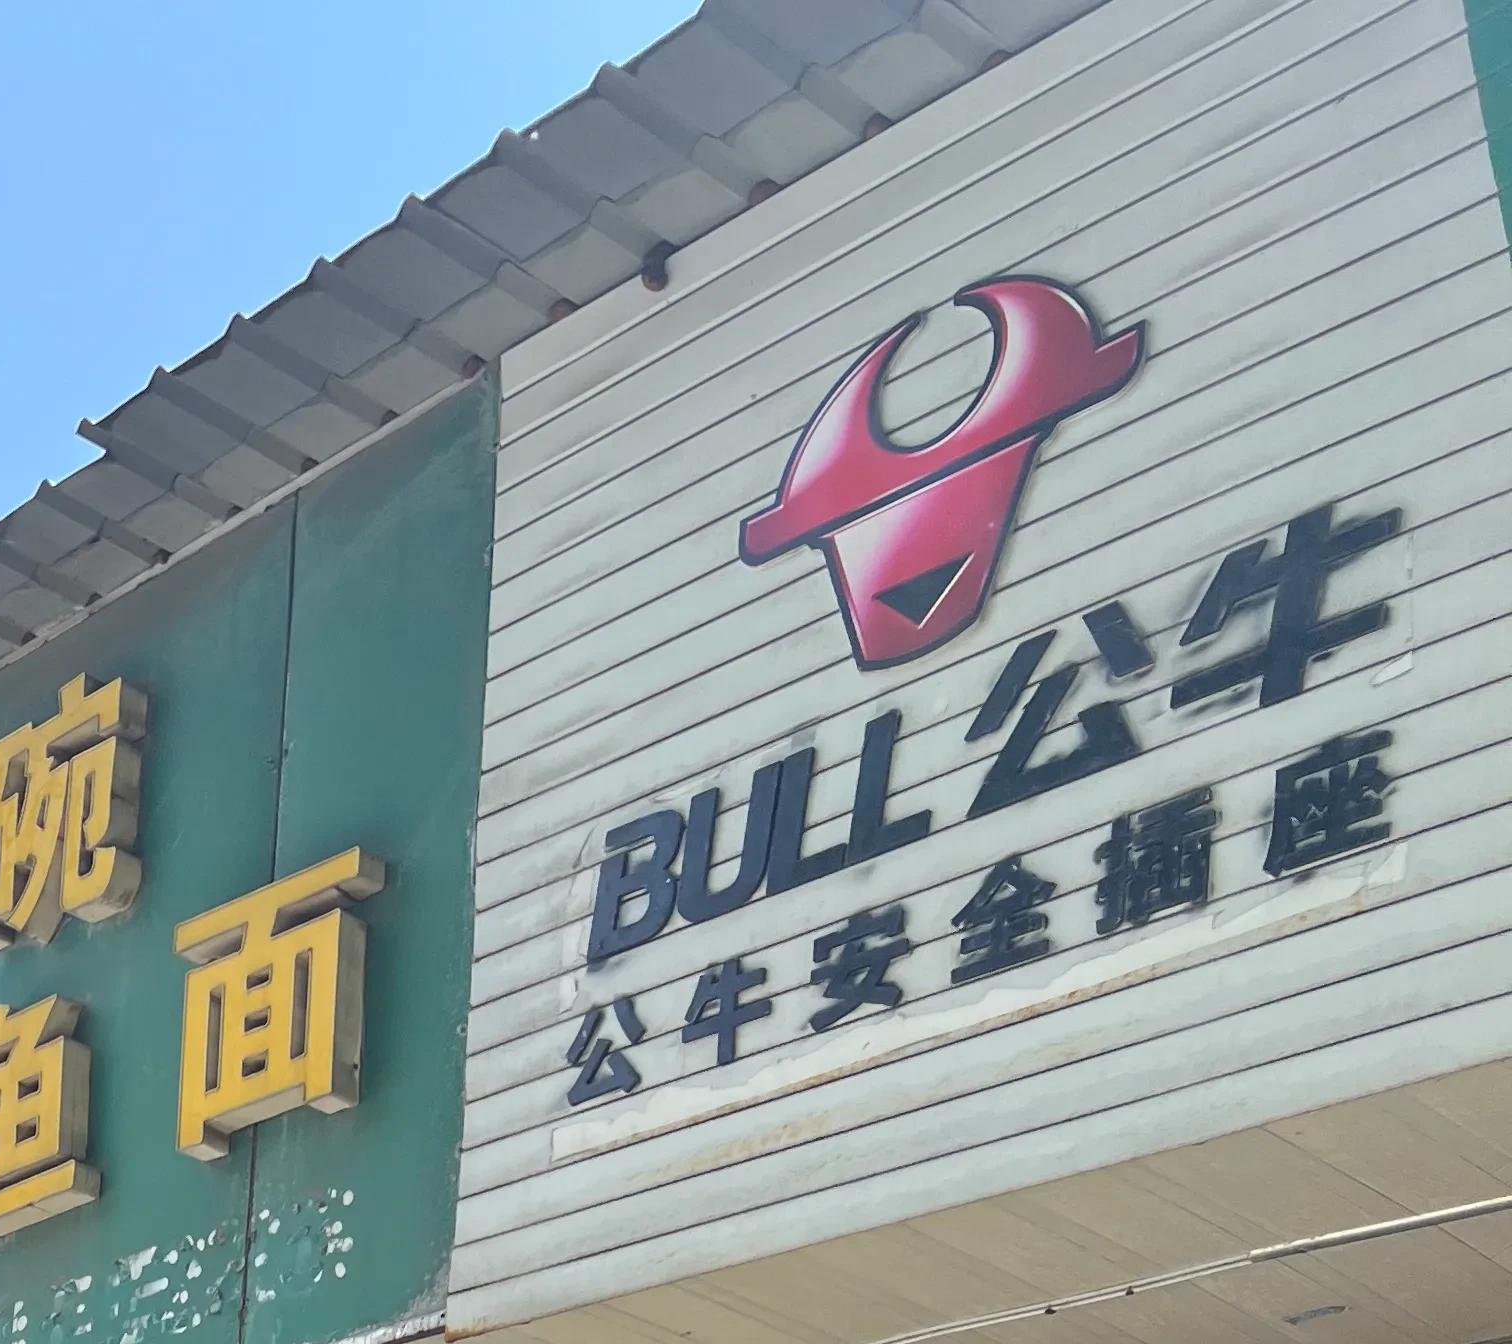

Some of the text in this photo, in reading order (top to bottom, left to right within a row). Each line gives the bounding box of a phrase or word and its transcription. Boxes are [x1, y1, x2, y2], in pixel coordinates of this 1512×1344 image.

[564, 730, 1395, 1107] 公牛安全插座
[587, 502, 1404, 968] BULL 公牛
